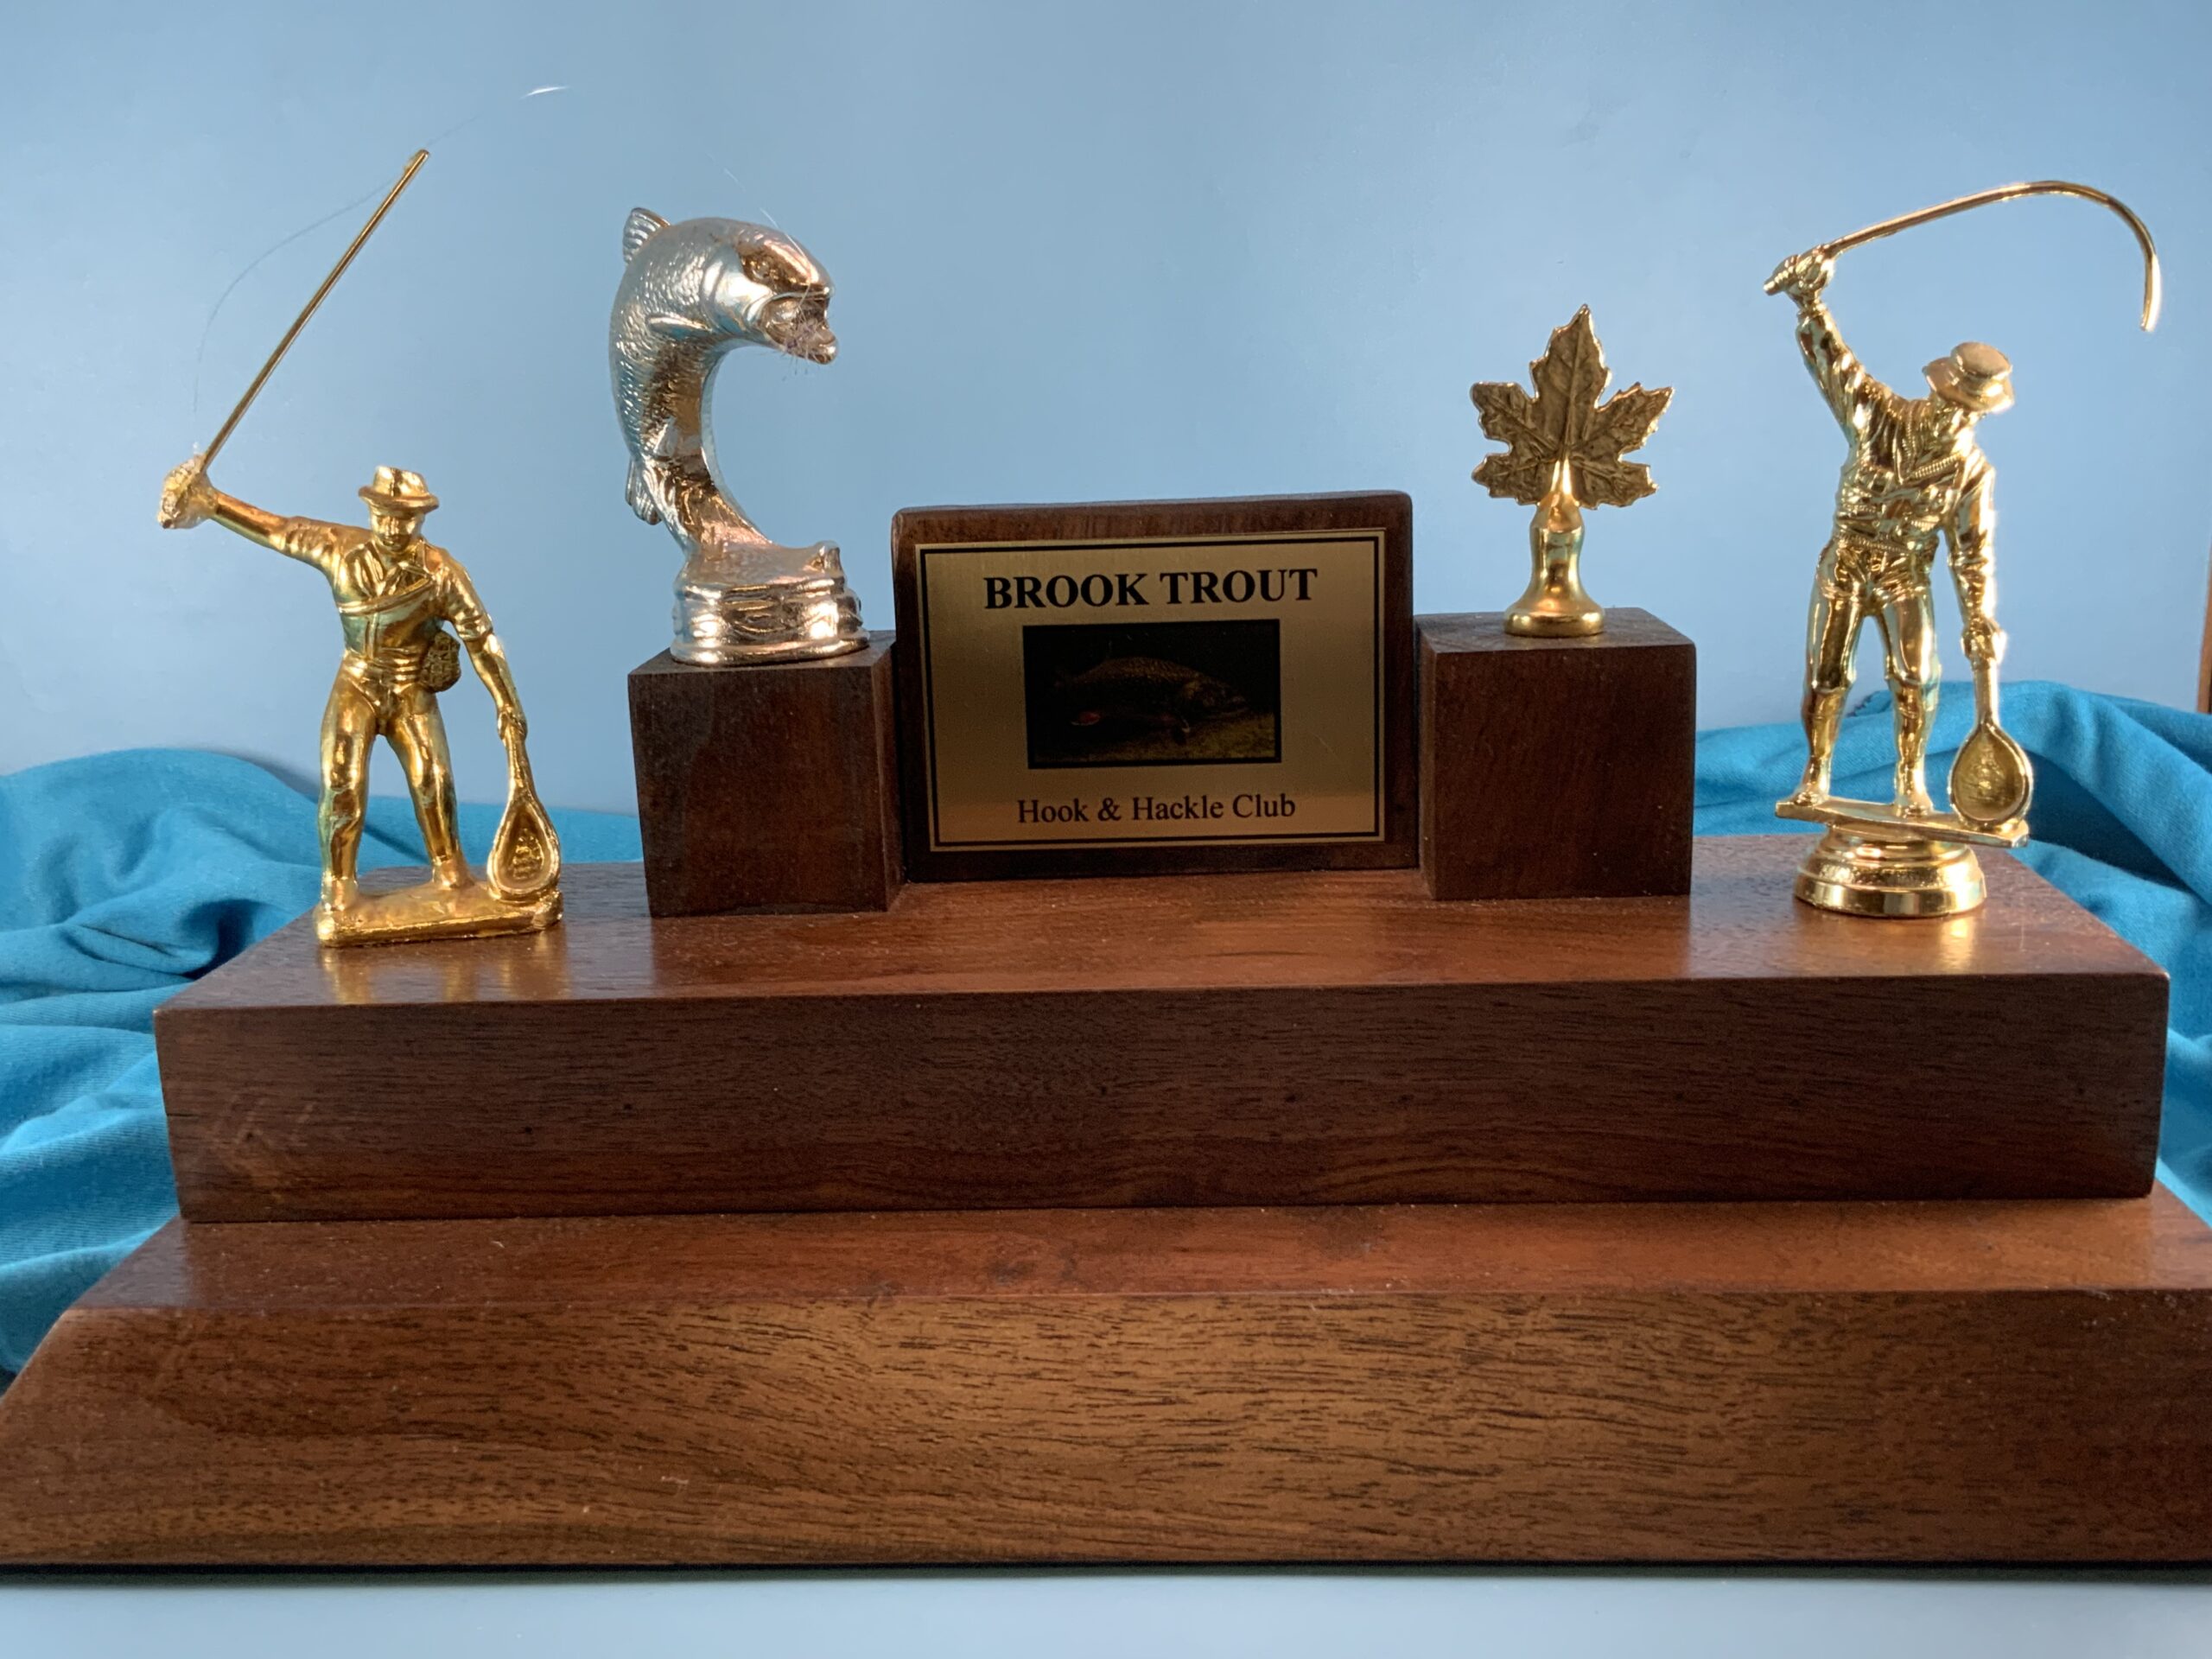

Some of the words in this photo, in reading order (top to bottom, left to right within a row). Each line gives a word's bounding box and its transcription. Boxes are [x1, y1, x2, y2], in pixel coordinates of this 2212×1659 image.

[983, 573, 1151, 609] BROOK
[1159, 568, 1319, 605] TROUT
[1017, 798, 1090, 824] Hook
[1096, 798, 1122, 822] &
[1131, 795, 1224, 821] Hackle
[1232, 793, 1296, 819] Club
